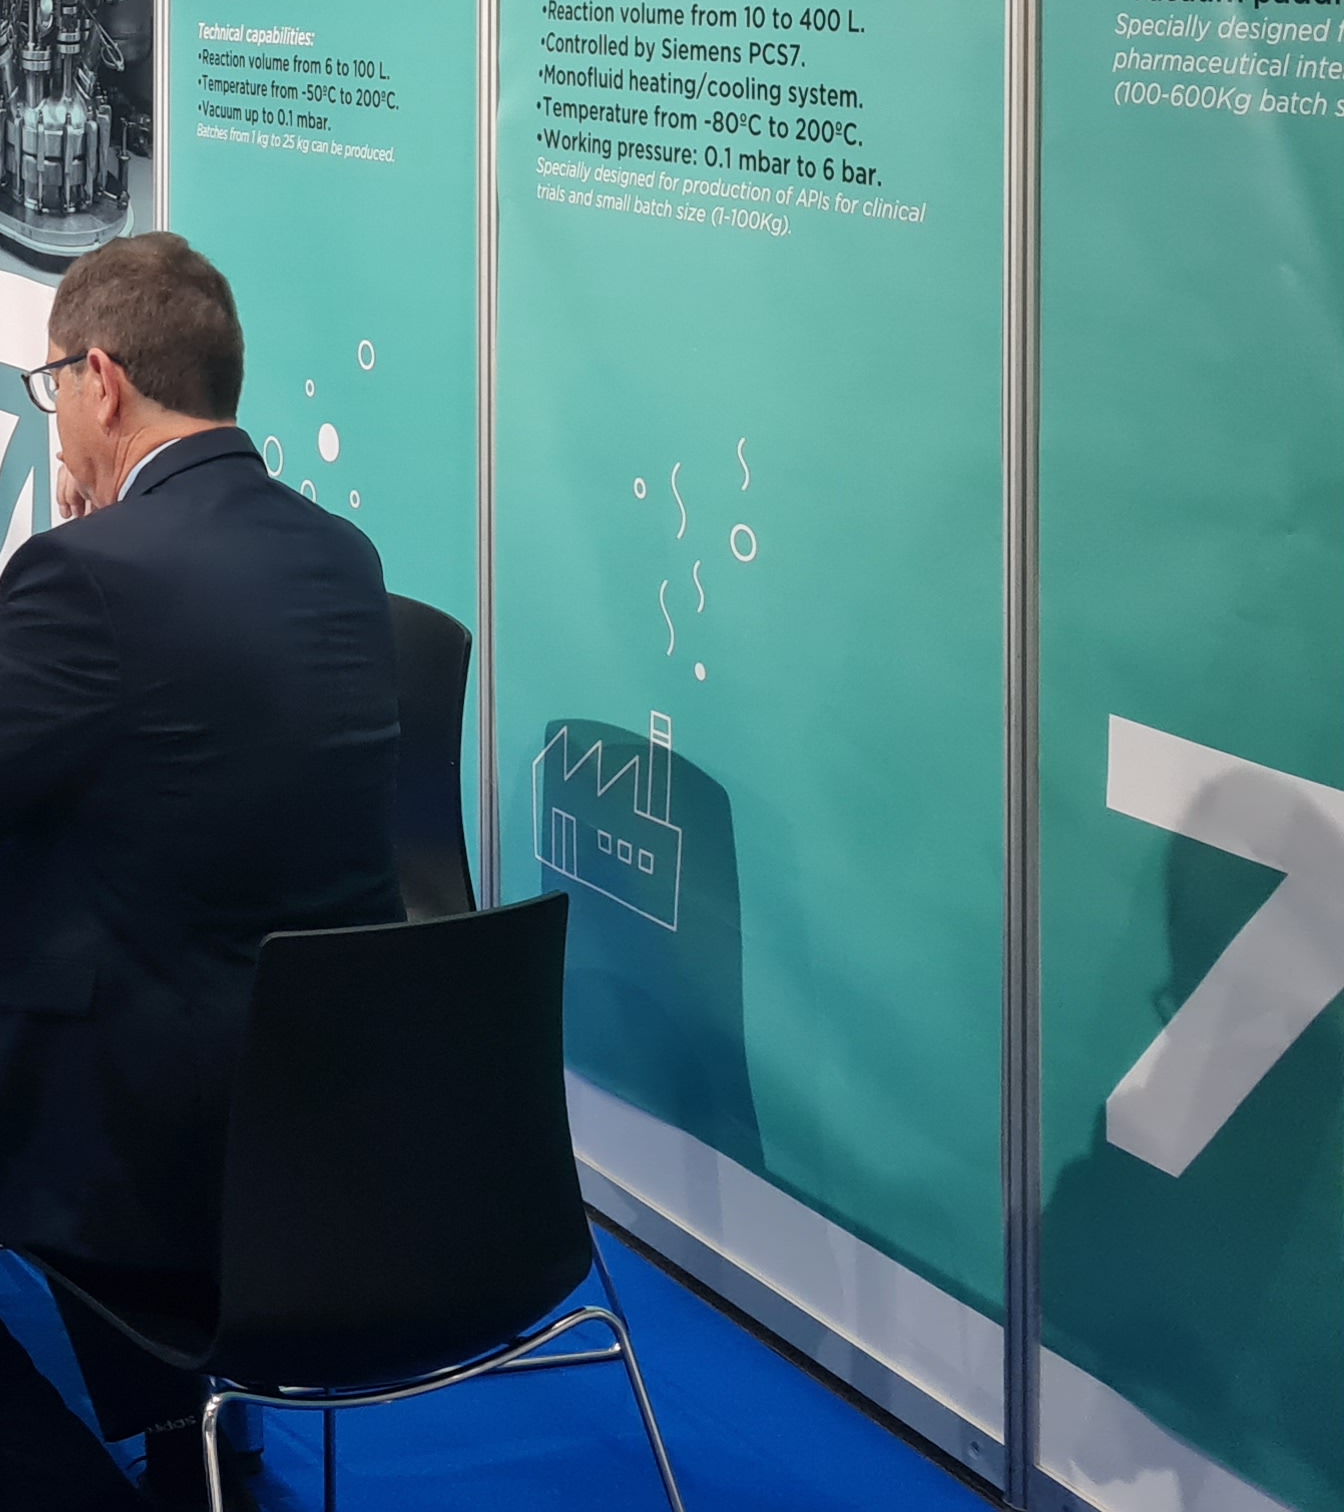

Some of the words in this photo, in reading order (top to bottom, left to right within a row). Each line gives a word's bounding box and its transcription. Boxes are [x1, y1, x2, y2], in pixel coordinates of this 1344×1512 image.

[620, 1, 684, 25] volume
[690, 3, 736, 27] from
[744, 5, 765, 28] 10
[772, 7, 792, 29] to
[799, 7, 840, 32] 400
[848, 9, 864, 33] L.
[1114, 12, 1211, 42] Specially
[1217, 14, 1331, 44] designed
[198, 22, 244, 41] Technical
[245, 25, 315, 46] capabilities:
[634, 35, 655, 62] by
[661, 37, 741, 63] Siemens
[749, 41, 805, 67] PCS7.
[1112, 46, 1290, 77] pharmaceutical
[1114, 80, 1251, 114] (100-600Kg
[1258, 88, 1327, 115] batch
